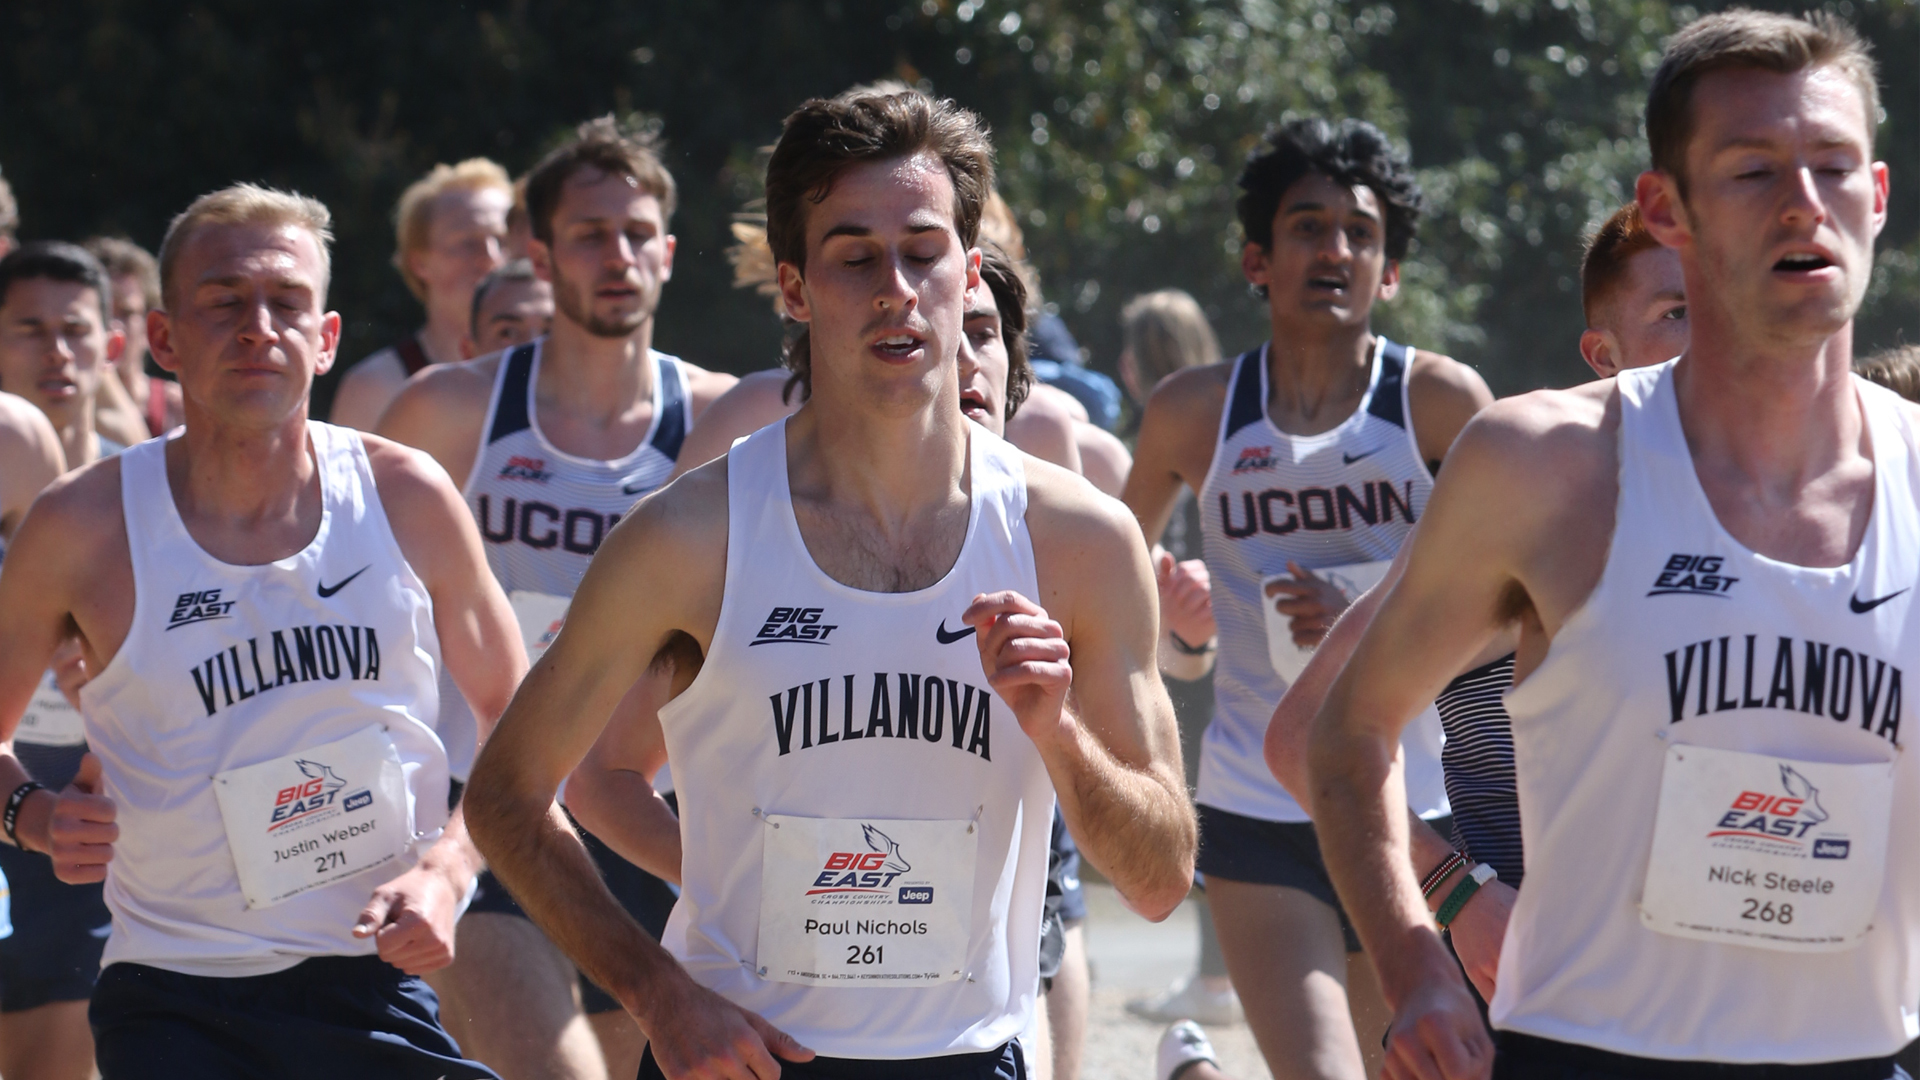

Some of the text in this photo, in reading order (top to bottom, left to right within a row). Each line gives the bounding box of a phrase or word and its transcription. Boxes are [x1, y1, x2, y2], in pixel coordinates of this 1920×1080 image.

[1218, 480, 1417, 539] UCONN
[477, 494, 622, 555] UCO
[1663, 553, 1725, 573] BIG
[1653, 572, 1741, 593] EAST
[175, 588, 222, 608] BIG
[169, 601, 236, 623] EAST
[766, 607, 825, 625] BIG
[756, 623, 838, 640] EAST
[190, 624, 381, 717] VILLANOVA
[1663, 633, 1903, 746] VILLANOVA
[769, 672, 992, 762] VILLANOVA
[274, 777, 325, 806] BIG
[1730, 790, 1804, 817] BIG
[270, 787, 341, 823] EAST
[1715, 811, 1818, 838] EAST
[273, 839, 320, 863] Justin
[322, 819, 377, 845] Weber
[314, 850, 347, 873] 271
[823, 852, 888, 870] BIG
[812, 871, 902, 888] EAST
[1707, 865, 1835, 895] Nick Steele
[902, 889, 930, 902] Jeep
[1740, 898, 1794, 925] 268
[804, 918, 928, 935] Paul Nichols
[846, 945, 884, 965] 261
